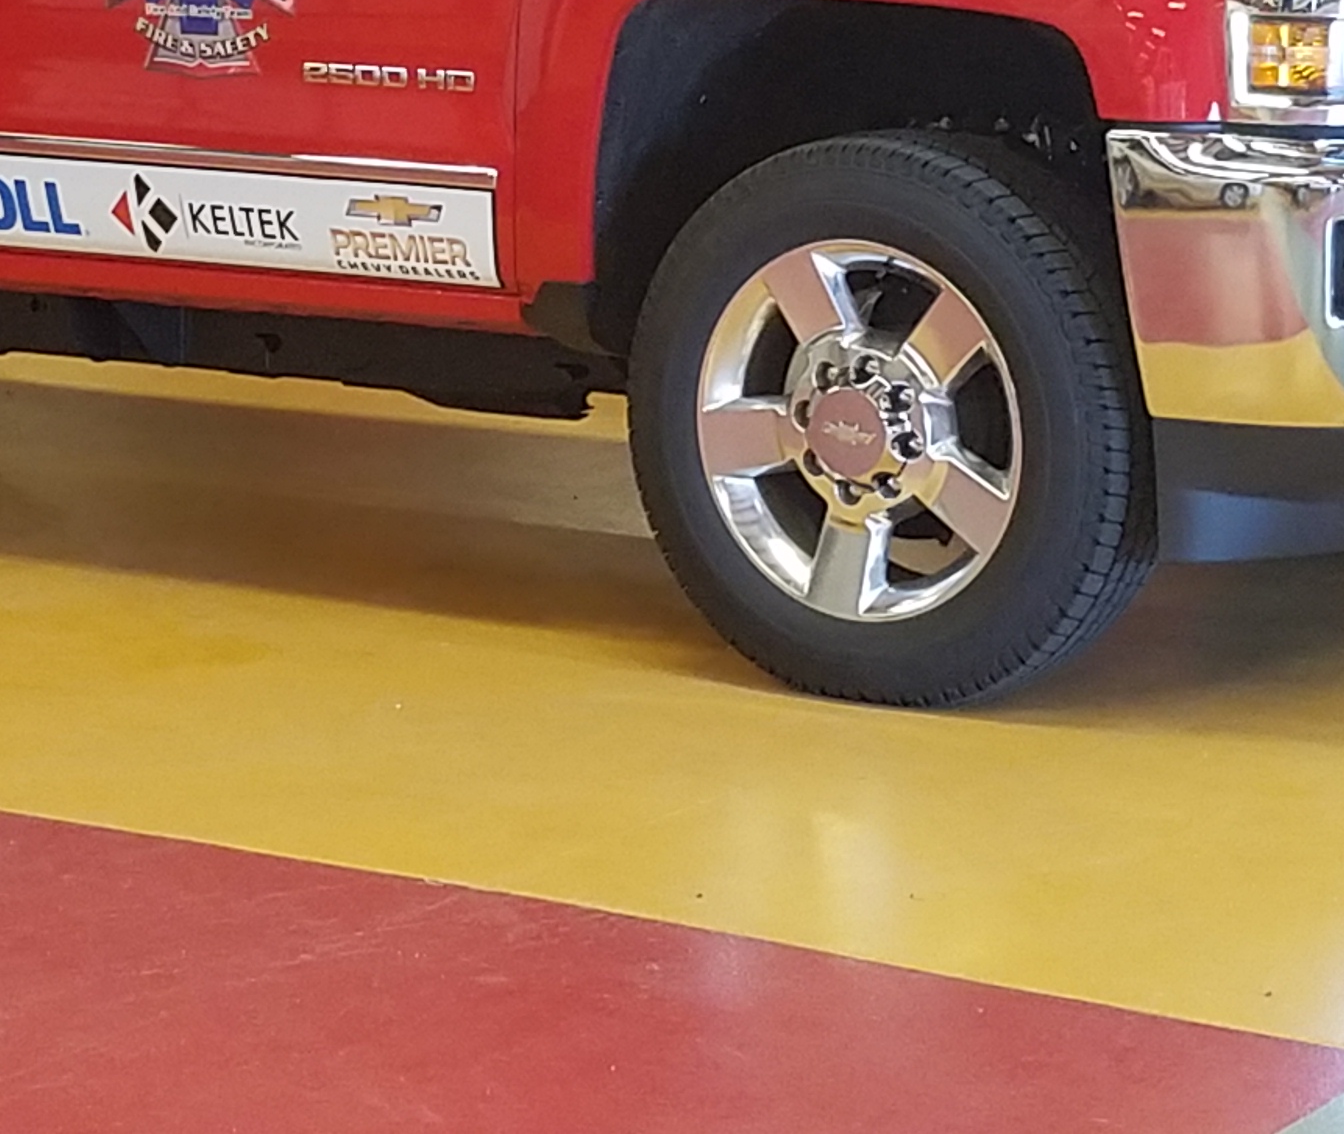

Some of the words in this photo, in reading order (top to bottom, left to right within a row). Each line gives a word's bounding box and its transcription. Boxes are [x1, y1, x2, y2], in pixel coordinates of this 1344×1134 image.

[135, 17, 177, 50] FIRE
[180, 40, 195, 56] &
[199, 22, 270, 57] SAFETY
[302, 61, 407, 89] 2500
[417, 68, 476, 93] HD
[188, 201, 300, 242] KELTEK
[329, 227, 472, 267] PREMIER
[336, 259, 394, 274] CHEVY
[400, 265, 481, 281] DEALERS
